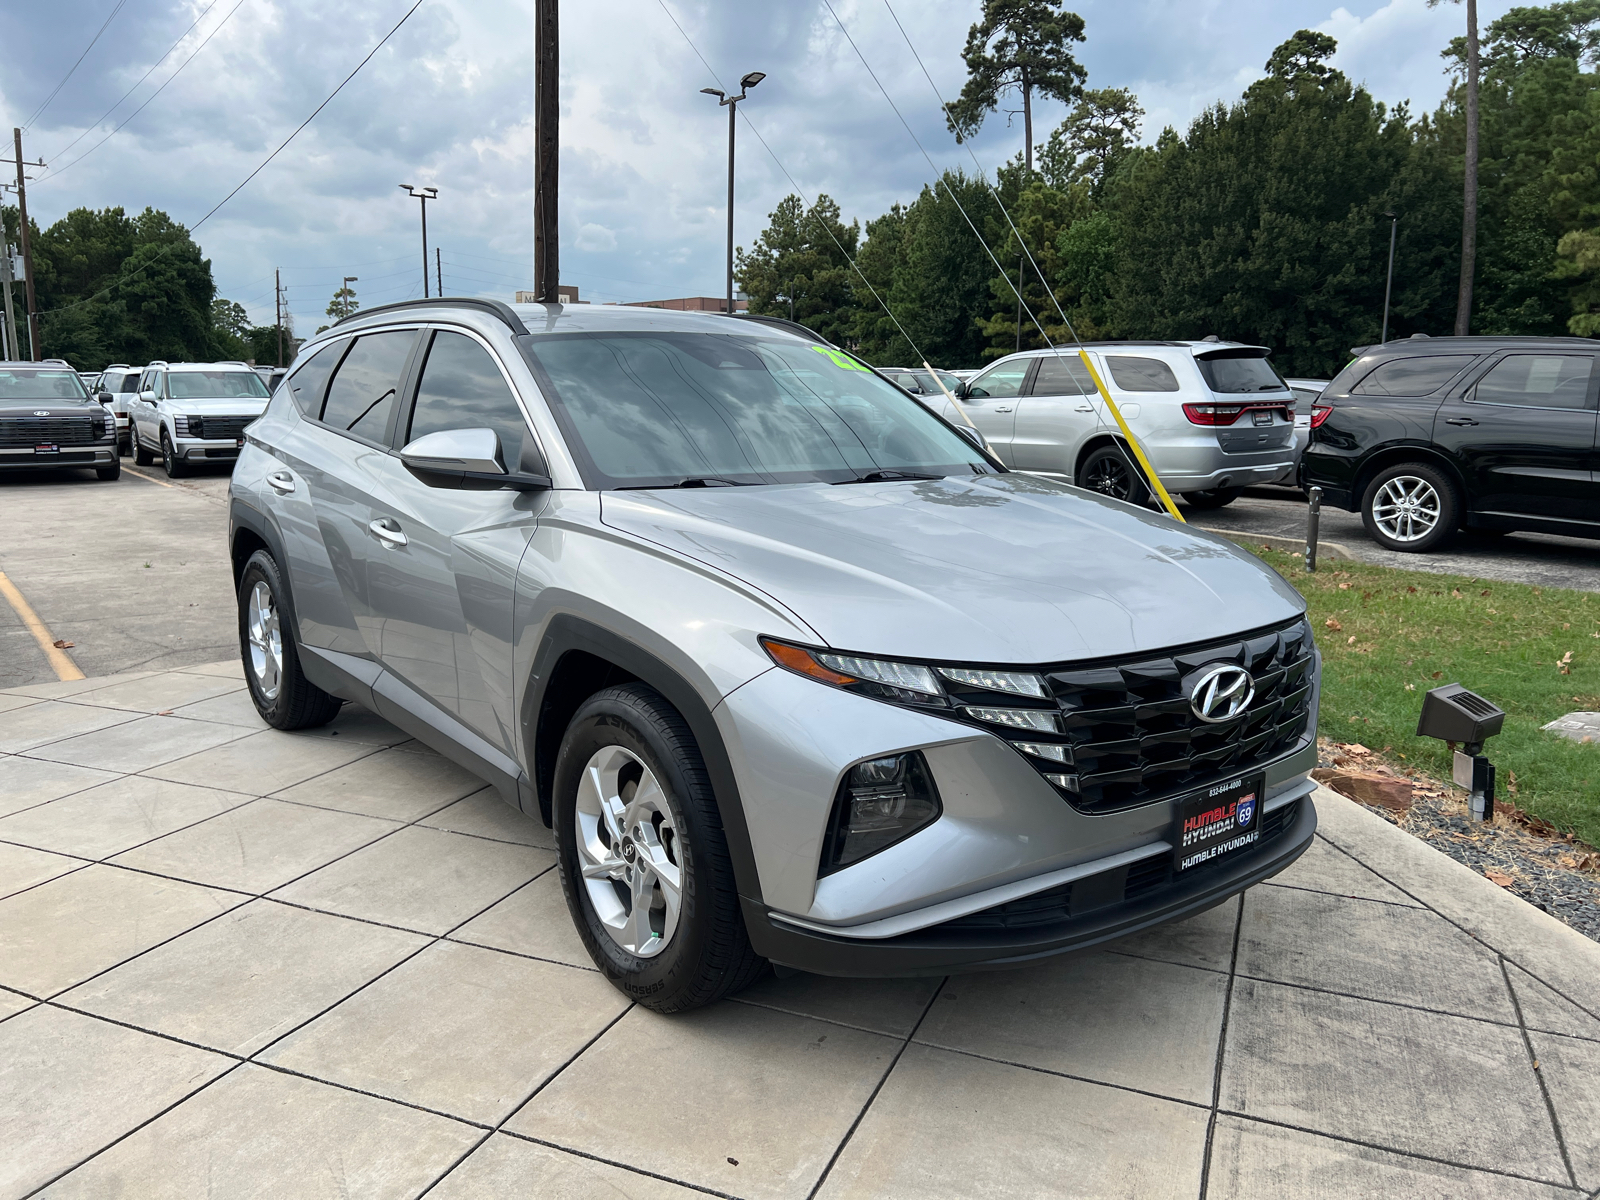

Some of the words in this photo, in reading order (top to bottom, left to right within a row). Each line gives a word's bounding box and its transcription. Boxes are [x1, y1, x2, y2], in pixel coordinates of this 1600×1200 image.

[1208, 779, 1242, 797] 832-644-4000
[1183, 802, 1236, 833] HUMBLE
[1239, 806, 1252, 823] 69
[1182, 817, 1235, 847] HYUNDAI
[1181, 847, 1217, 870] HUMBLE
[1217, 832, 1254, 855] HYUNDAI
[624, 979, 665, 995] SEASON
